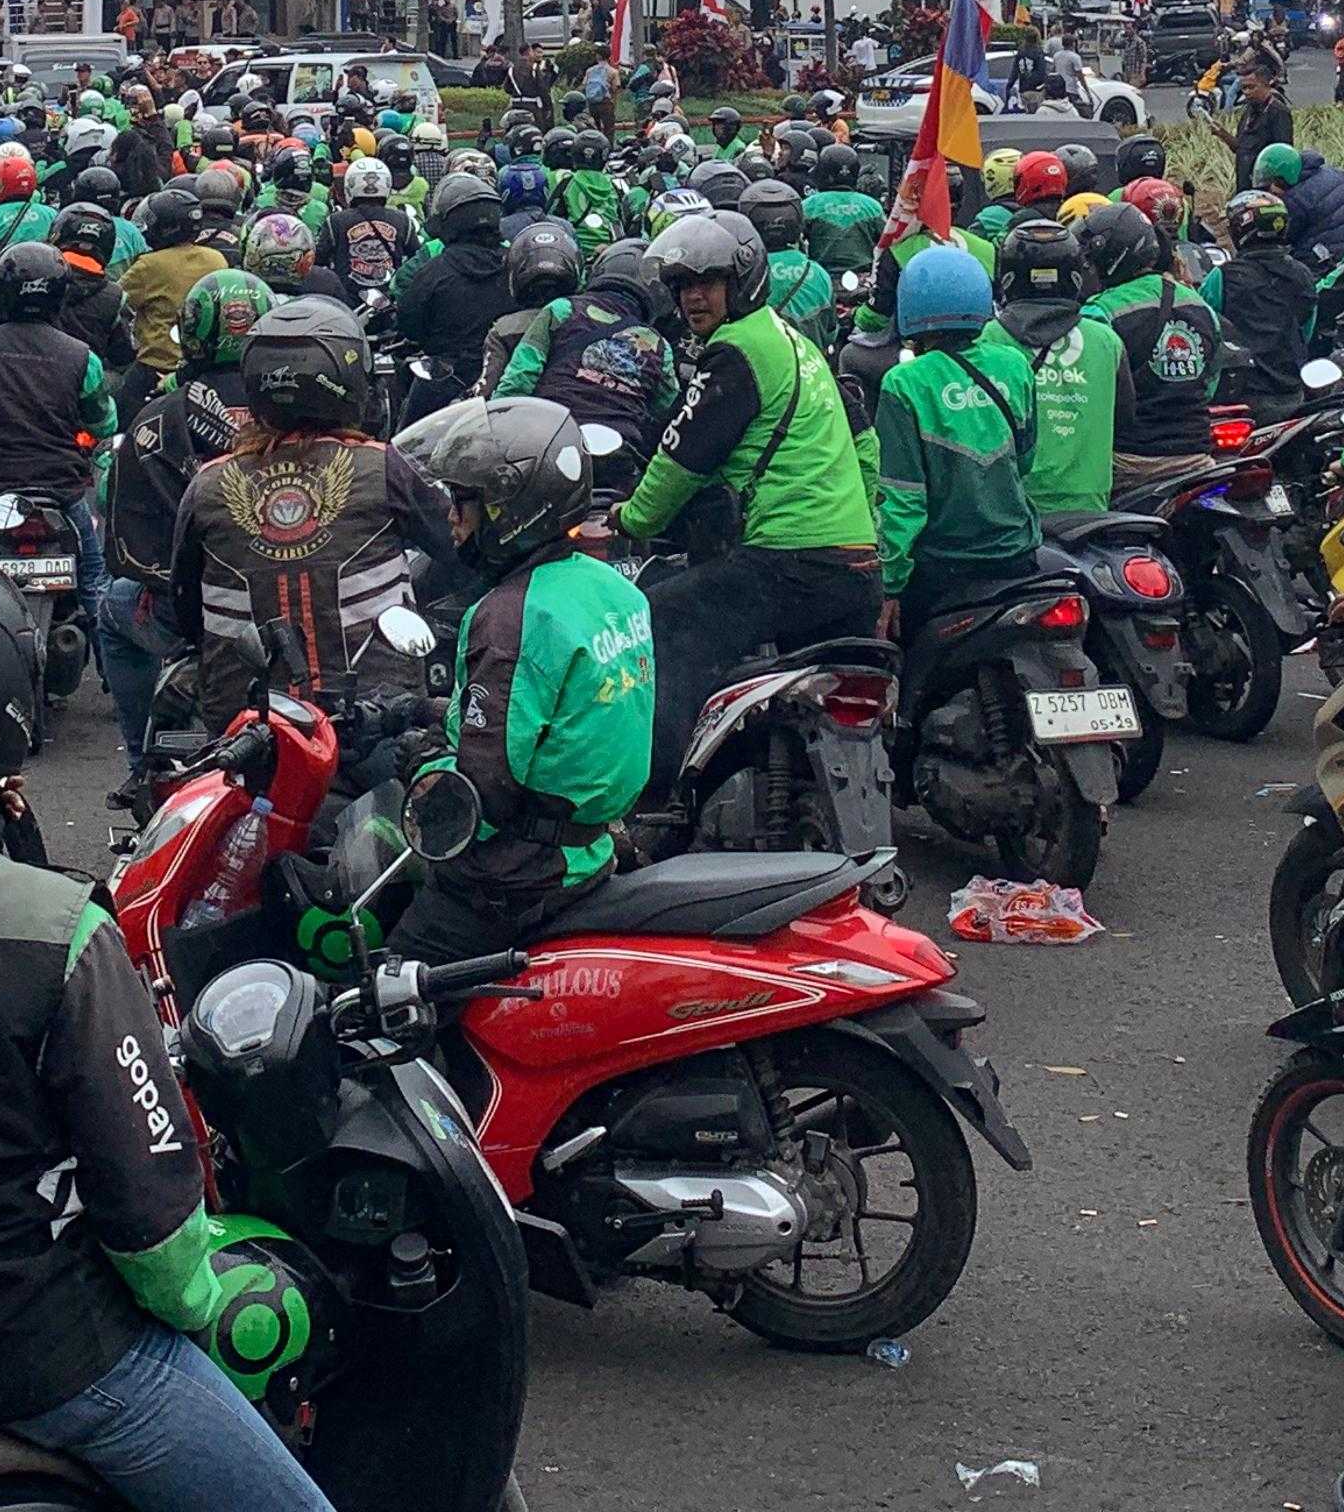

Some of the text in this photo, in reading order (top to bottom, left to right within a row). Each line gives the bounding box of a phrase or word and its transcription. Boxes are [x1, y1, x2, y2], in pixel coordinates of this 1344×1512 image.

[1035, 367, 1088, 387] gojek
[1031, 692, 1130, 715] Z 5257 DBM
[115, 1034, 183, 1156] gopay
